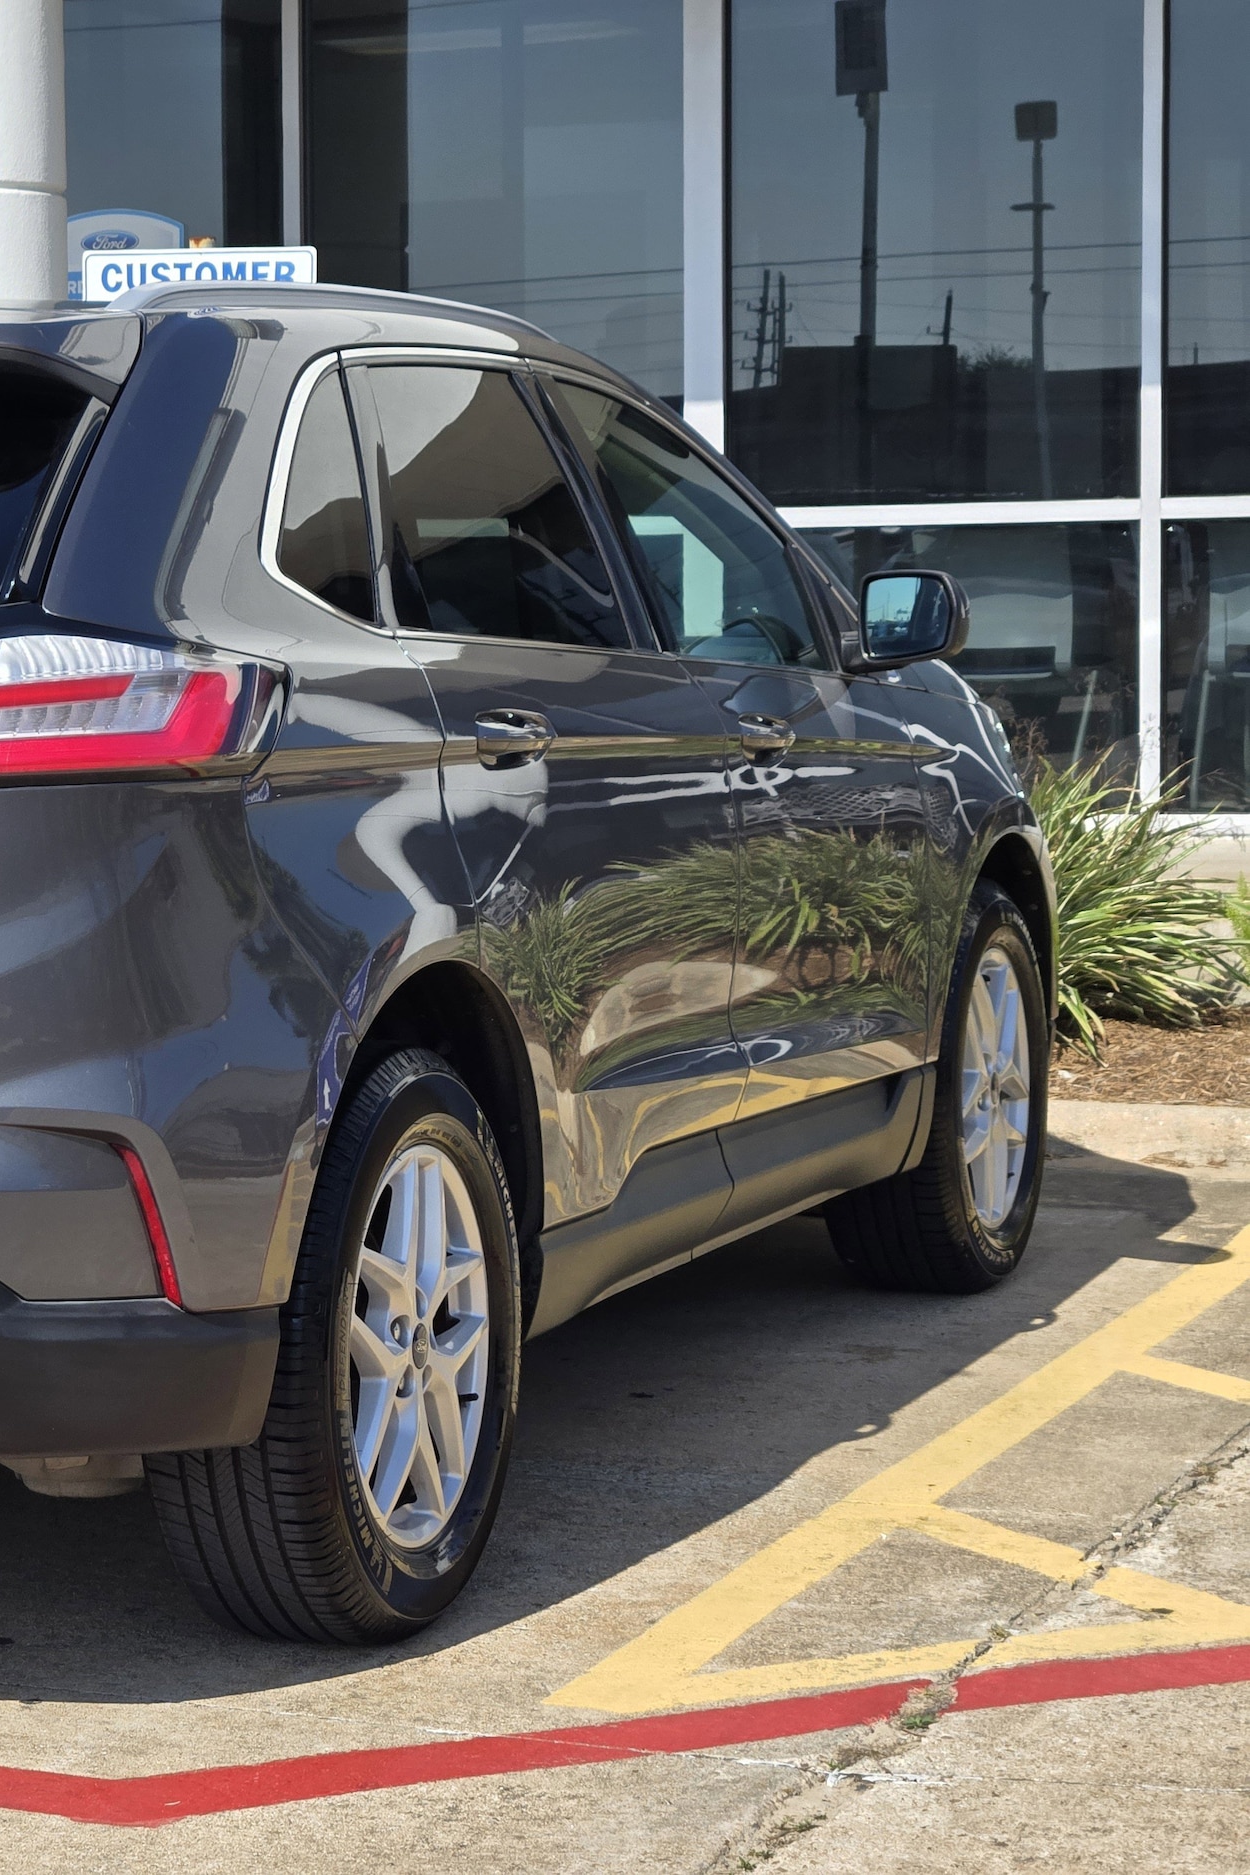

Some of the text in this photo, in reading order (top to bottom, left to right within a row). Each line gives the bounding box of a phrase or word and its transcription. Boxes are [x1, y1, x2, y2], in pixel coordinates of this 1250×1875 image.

[92, 234, 127, 250] Ford
[101, 261, 296, 293] CUSTOMER
[339, 1417, 372, 1549] MICHELIN
